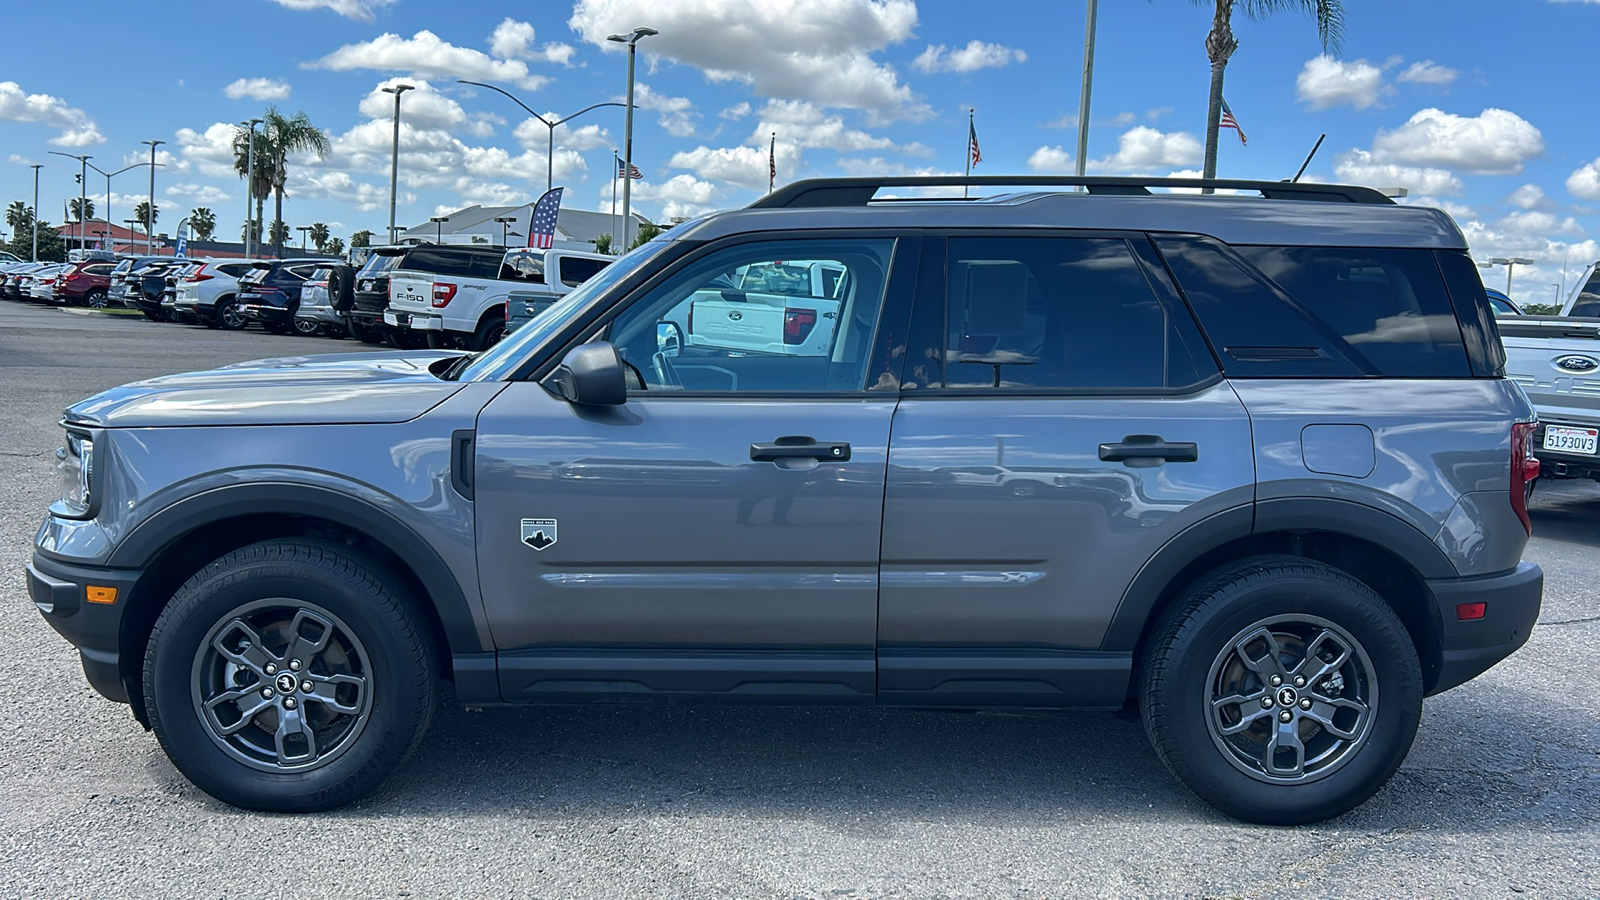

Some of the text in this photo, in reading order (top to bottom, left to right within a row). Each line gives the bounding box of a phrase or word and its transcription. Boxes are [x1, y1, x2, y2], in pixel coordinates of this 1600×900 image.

[397, 293, 424, 302] F-150
[1565, 358, 1588, 369] Ford
[1556, 427, 1586, 436] California
[1548, 435, 1594, 450] 51930V3
